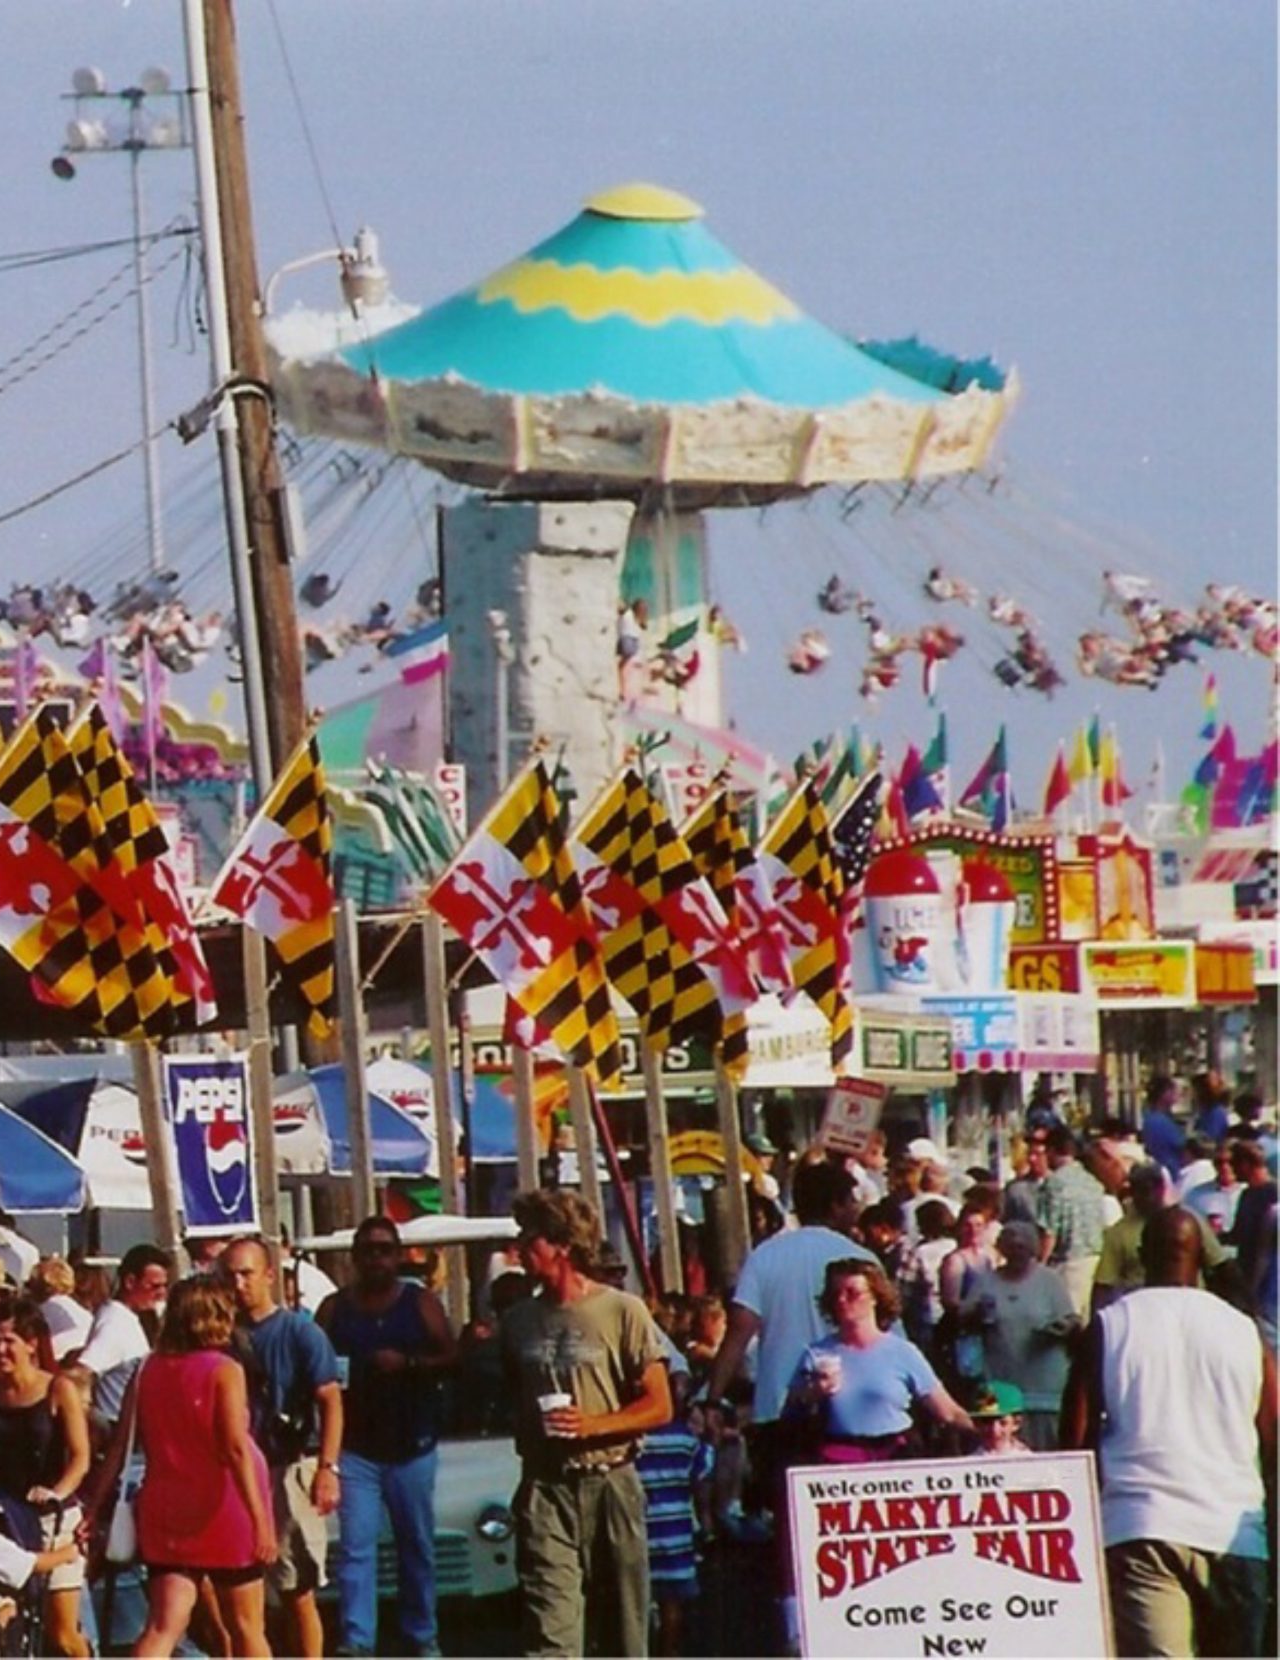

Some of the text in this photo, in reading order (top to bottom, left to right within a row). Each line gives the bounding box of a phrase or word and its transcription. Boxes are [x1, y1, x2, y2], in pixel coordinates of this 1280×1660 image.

[175, 1077, 243, 1124] PEPSI
[808, 1471, 1005, 1498] Welcome to the
[815, 1489, 1072, 1536] MARYLAND
[816, 1528, 1082, 1601] STATE FAIR
[845, 1595, 1059, 1628] Come See Our
[923, 1635, 987, 1657] New
